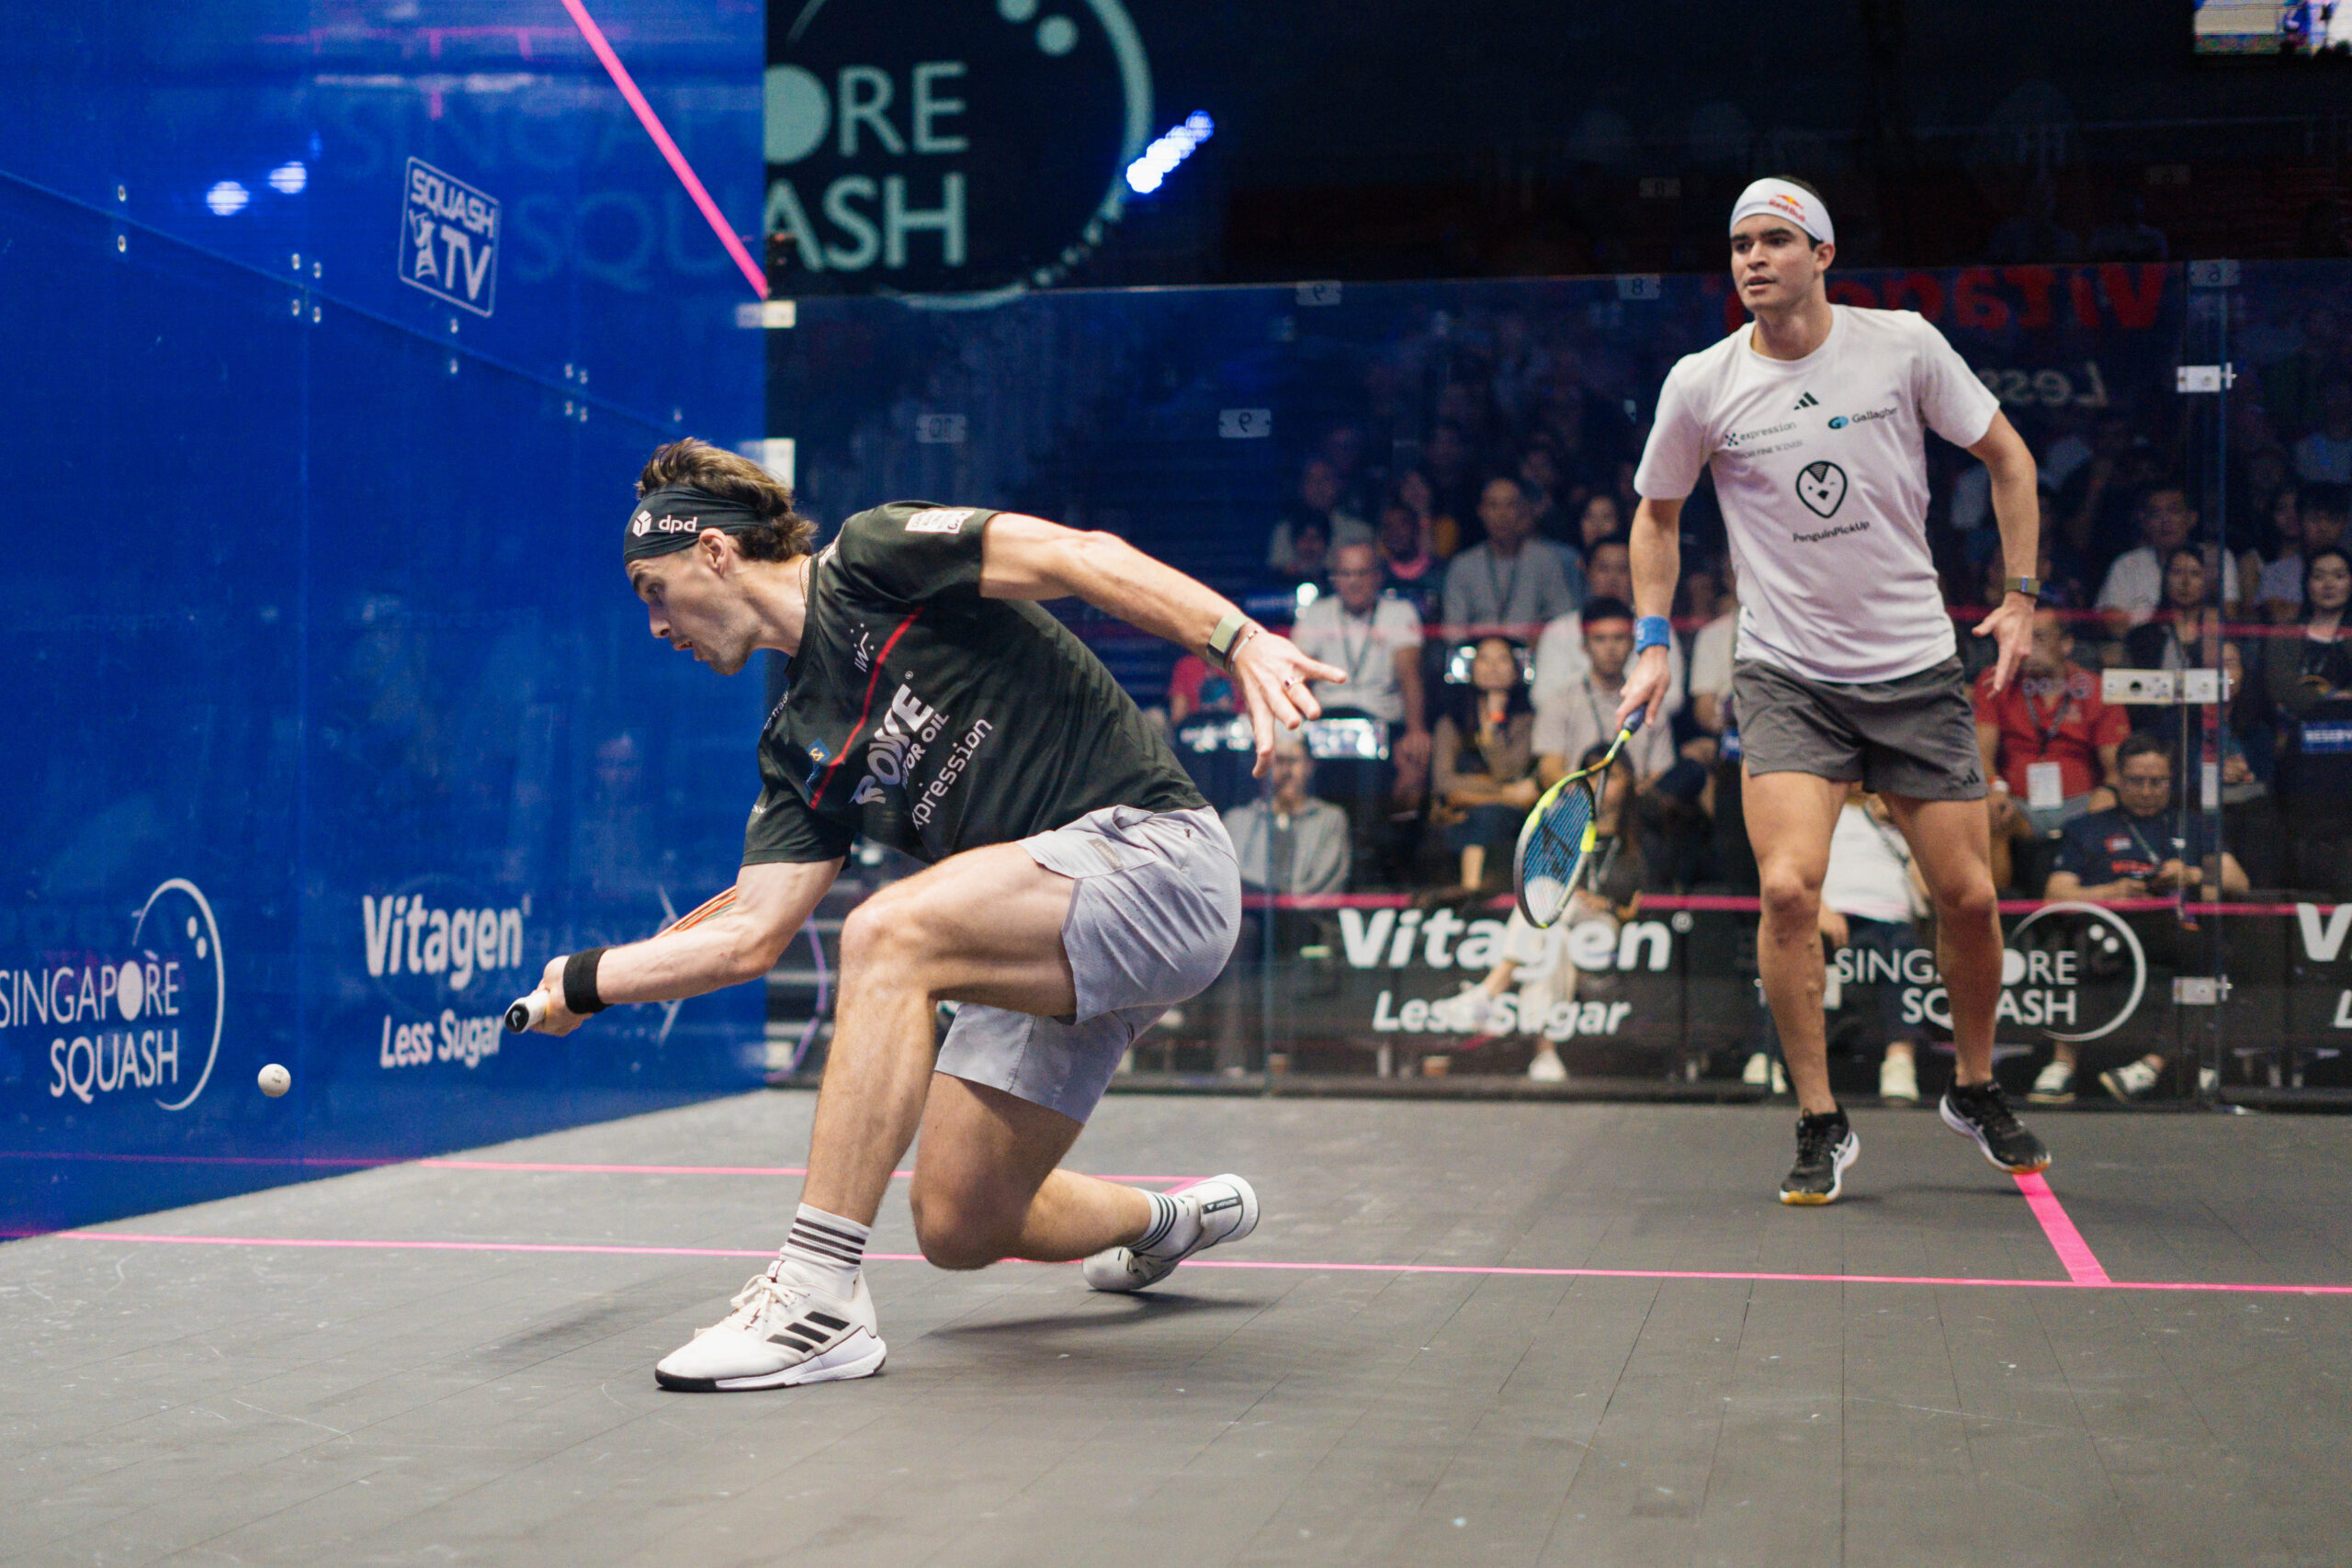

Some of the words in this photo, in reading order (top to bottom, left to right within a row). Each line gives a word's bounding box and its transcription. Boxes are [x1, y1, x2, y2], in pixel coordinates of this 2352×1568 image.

[411, 168, 495, 239] SQUASH
[1769, 199, 1790, 211] Red
[1789, 208, 1806, 222] Bull
[440, 225, 492, 300] TV
[1740, 422, 1797, 441] expression
[1851, 407, 1897, 423] Gallagher
[658, 514, 698, 535] dpd
[1792, 520, 1871, 543] PenguinPickUp
[921, 713, 950, 752] OIL
[911, 718, 993, 830] xpression
[362, 894, 525, 991] Vitagen
[1337, 908, 1672, 984] Vitagen
[1834, 947, 2078, 987] SINGORE
[1372, 990, 1474, 1033] Less
[1486, 992, 1632, 1043] Sugar
[1901, 987, 2077, 1031] SQASH
[379, 1015, 435, 1068] Less
[437, 1009, 505, 1070] Sugar
[50, 1028, 178, 1104] SQUASH
